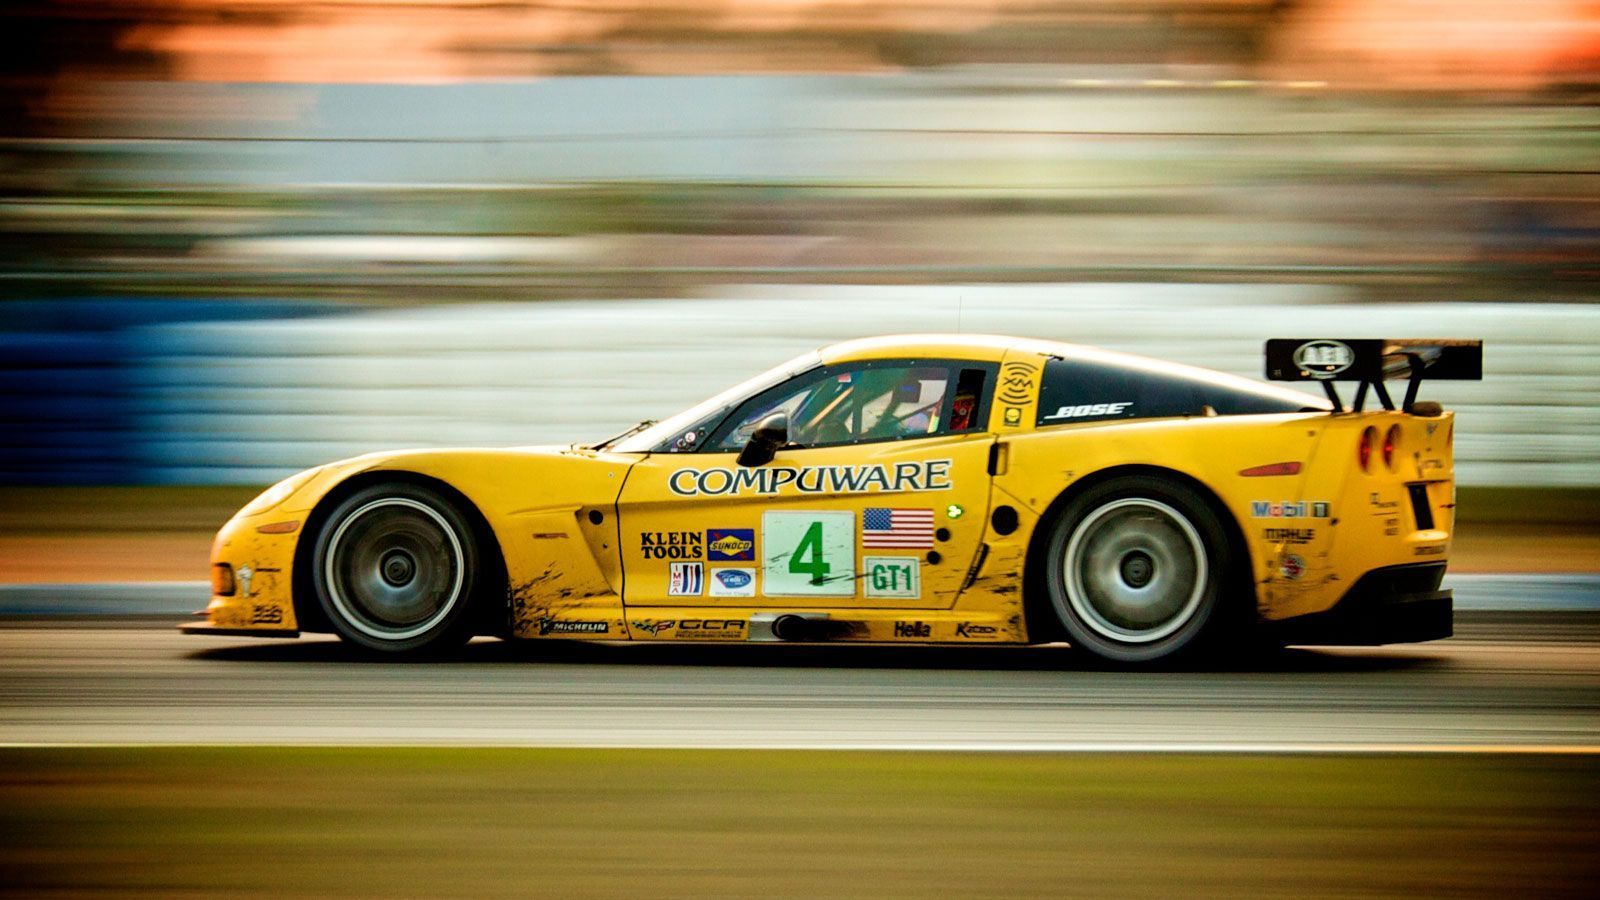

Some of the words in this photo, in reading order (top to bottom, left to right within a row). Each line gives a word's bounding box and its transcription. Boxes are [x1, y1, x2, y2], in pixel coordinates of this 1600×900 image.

[1003, 377, 1034, 389] XM
[1044, 402, 1134, 420] BOSE
[669, 460, 952, 496] COMPUWARE
[641, 532, 702, 545] KLEIN
[711, 542, 750, 550] SUNOCO
[641, 545, 703, 559] TOOLS
[789, 521, 830, 587] 4
[672, 564, 682, 594] IMSA
[872, 564, 912, 591] GT1
[553, 622, 607, 632] MICHELIN
